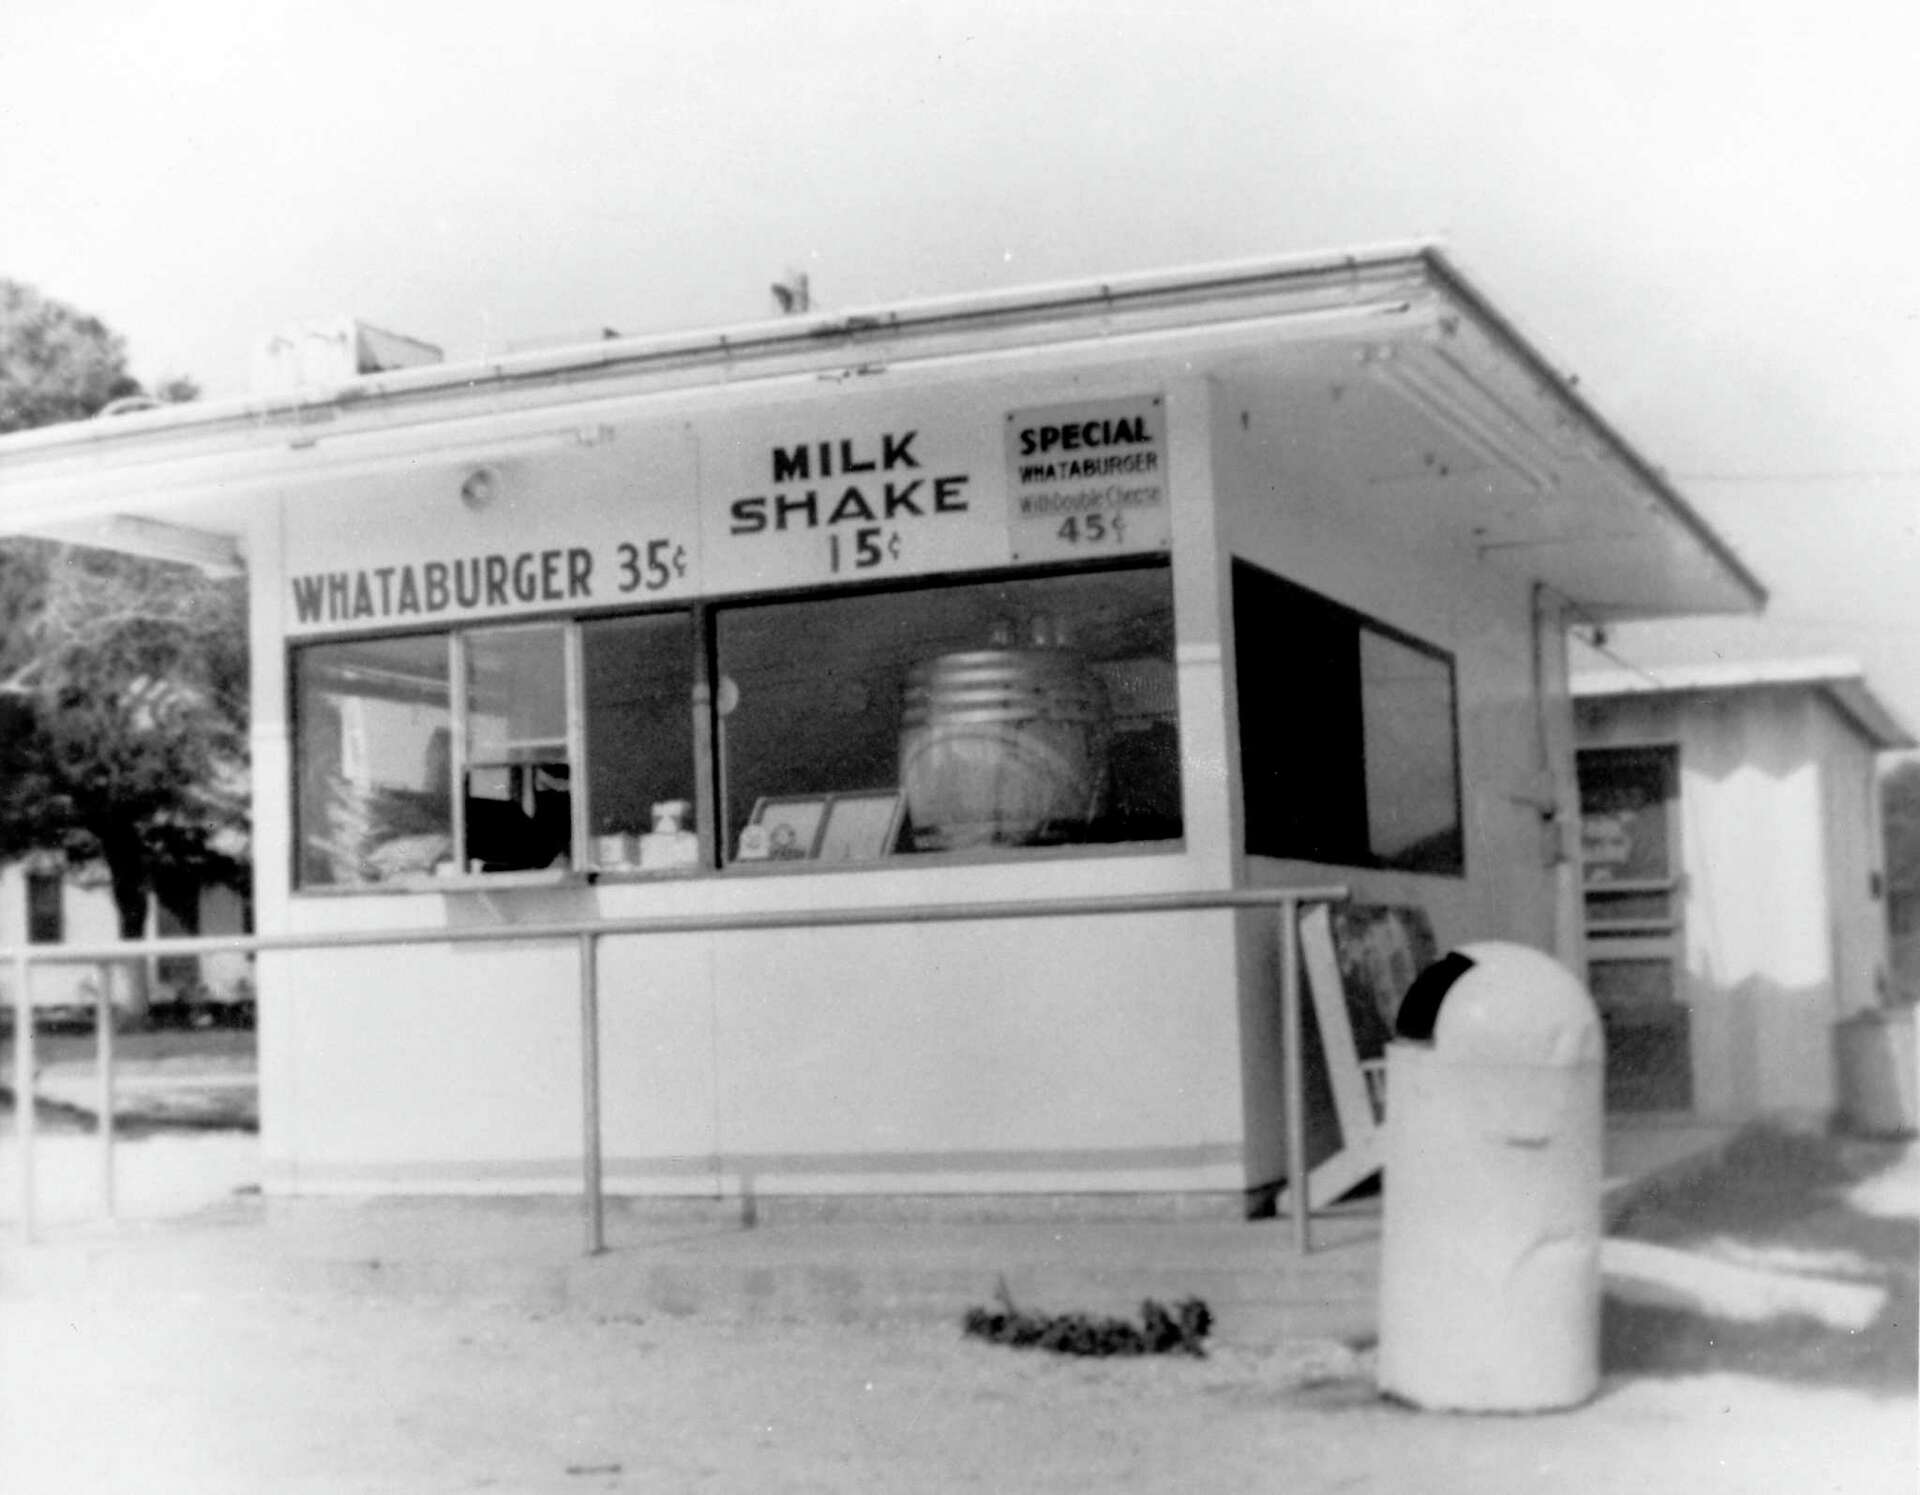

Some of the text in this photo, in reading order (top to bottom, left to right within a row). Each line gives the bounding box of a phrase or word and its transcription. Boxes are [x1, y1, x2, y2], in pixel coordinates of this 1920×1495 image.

[772, 430, 921, 483] MILK
[1020, 416, 1152, 455] SPECIAL
[1019, 452, 1157, 484] WHATABURGER
[730, 475, 969, 535] SHAKE
[292, 547, 594, 624] WHATABURGER
